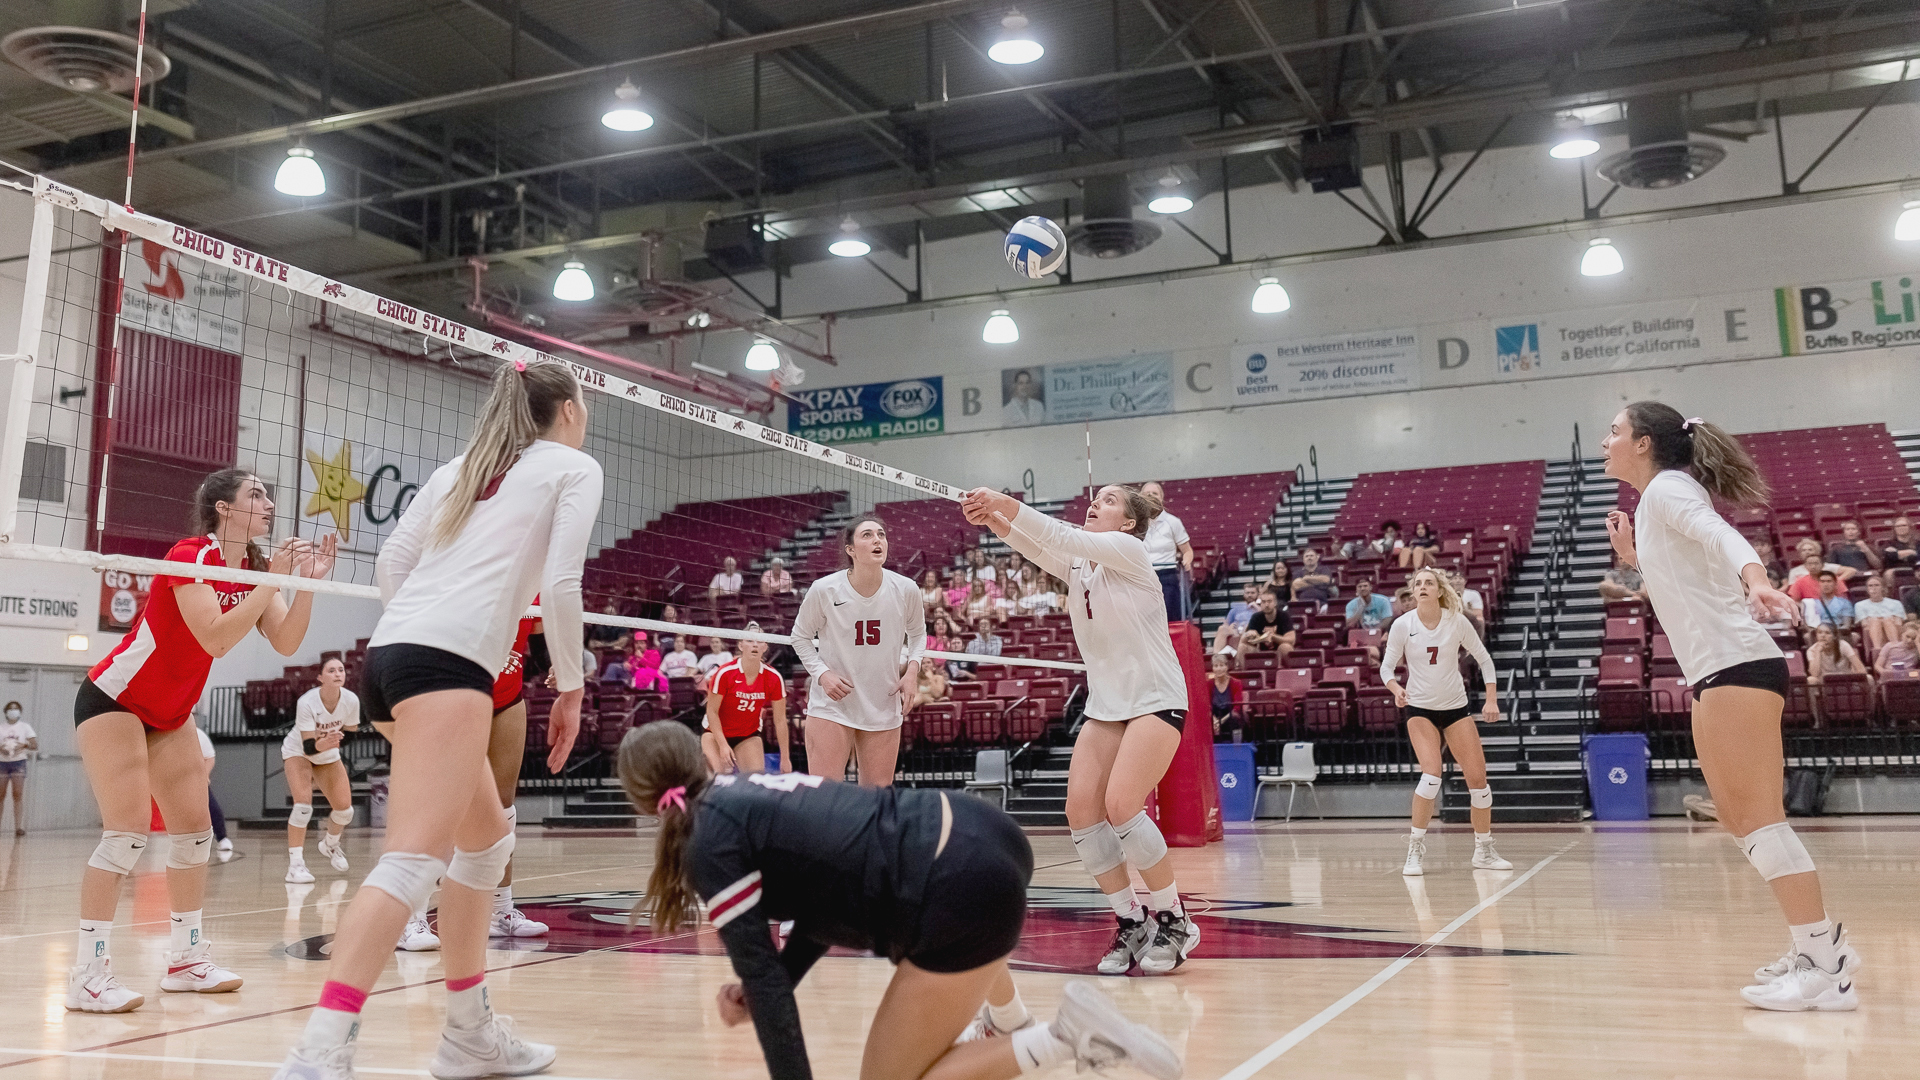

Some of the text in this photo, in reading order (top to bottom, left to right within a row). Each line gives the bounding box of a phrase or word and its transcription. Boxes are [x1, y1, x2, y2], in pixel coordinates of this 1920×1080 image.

[54, 186, 75, 197] Senoh
[172, 226, 290, 283] CHICO STATE
[123, 293, 160, 313] Slater
[376, 297, 467, 343] CHICO STATE
[1558, 317, 1695, 343] Together, Building
[1724, 308, 1749, 343] E
[1277, 334, 1415, 357] Best Western Heritage Inn
[1560, 335, 1701, 362] a Better California
[1805, 333, 1849, 350] Butte
[1436, 337, 1470, 371] D
[570, 363, 606, 388] STATE
[1185, 362, 1213, 394] C
[1246, 375, 1268, 386] Best
[1299, 362, 1395, 382] 20% discount
[1054, 377, 1075, 392] Dr.
[1080, 373, 1127, 390] Phillip
[1236, 384, 1279, 396] Western
[800, 387, 864, 410] KPAY
[893, 388, 922, 405] FOX
[961, 387, 982, 416] B
[660, 393, 717, 424] CHICO STATE
[800, 406, 864, 426] SPORTS
[878, 418, 940, 436] RADIO
[760, 427, 809, 452] CHICO STATE
[864, 460, 885, 476] STATE
[931, 482, 949, 496] STATE
[104, 571, 132, 590] GO
[29, 598, 79, 618] STRONG
[854, 619, 882, 646] 15
[1426, 646, 1439, 665] 7
[737, 699, 756, 713] 24
